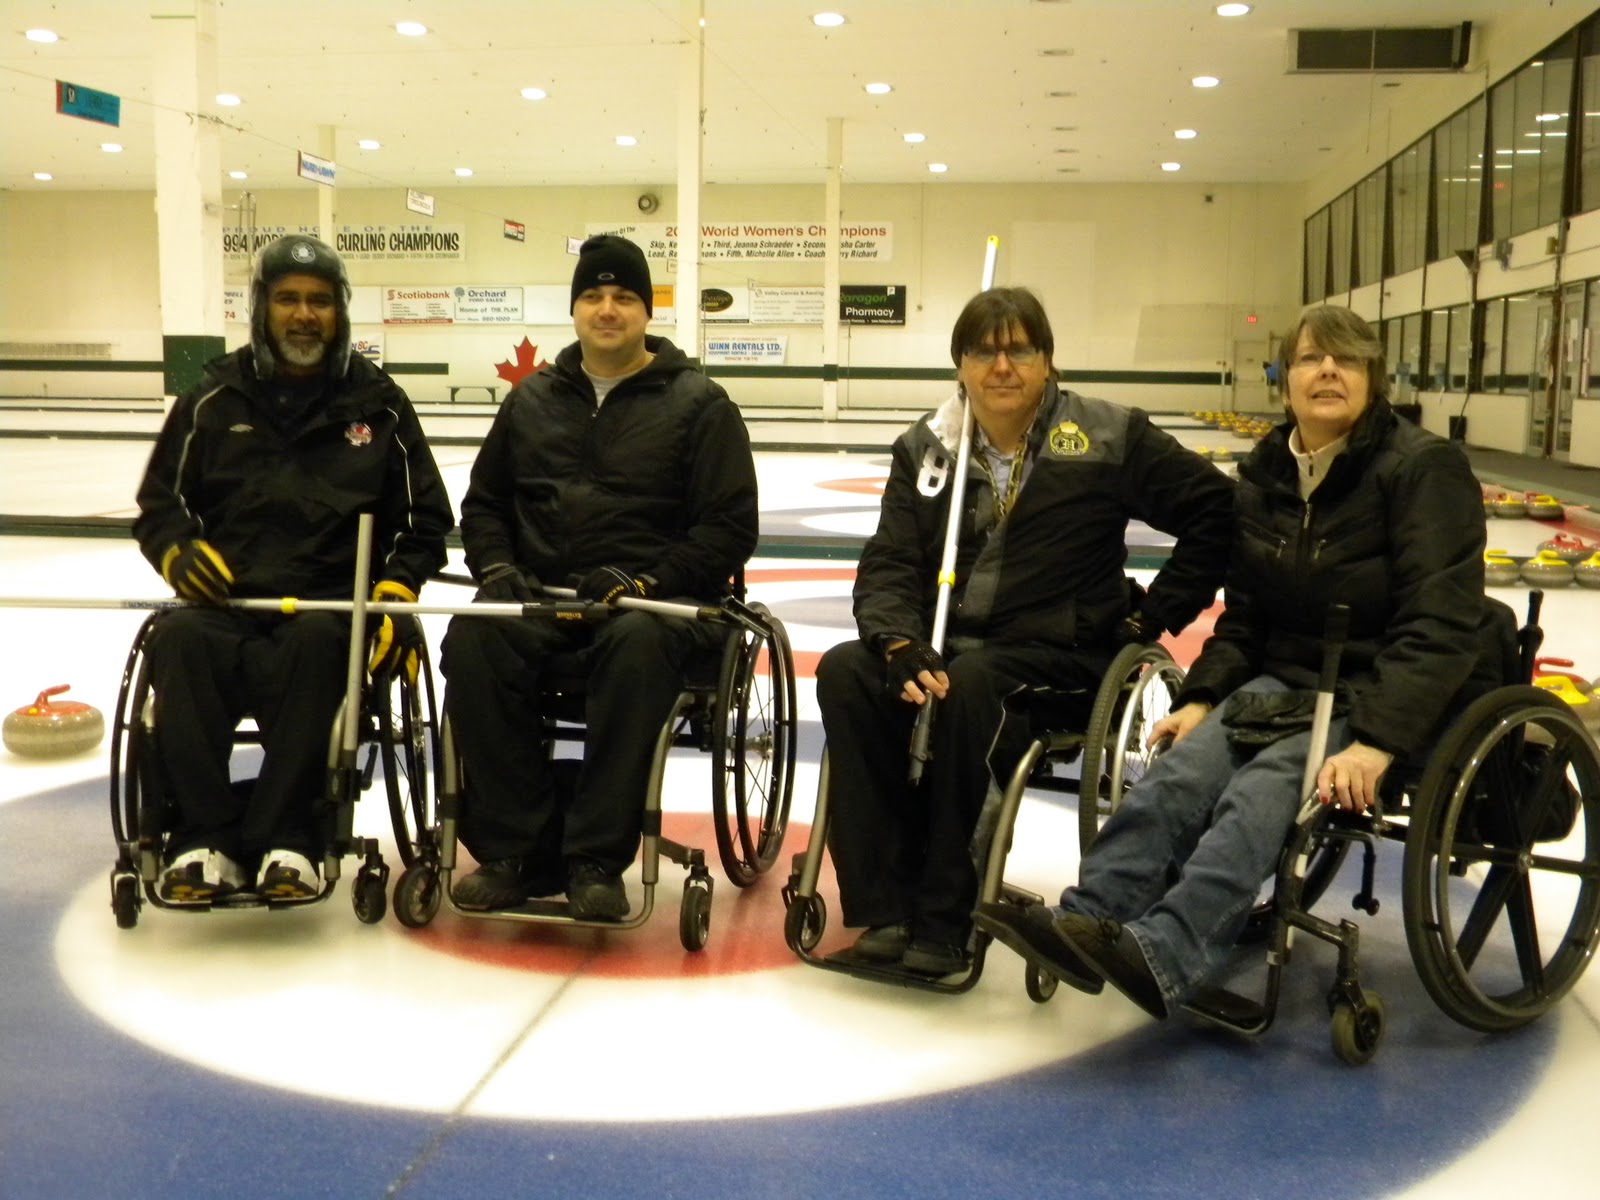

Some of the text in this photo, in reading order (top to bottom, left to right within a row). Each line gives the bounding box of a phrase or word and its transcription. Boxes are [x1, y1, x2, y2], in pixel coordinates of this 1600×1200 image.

[702, 226, 739, 237] World
[743, 226, 804, 237] Women's
[808, 225, 887, 239] Chmpions
[336, 233, 386, 252] CURLING
[389, 232, 460, 252] CHAMPIONS
[650, 240, 667, 249] Skip,
[713, 240, 733, 249] Third,
[854, 240, 876, 249] Carter
[648, 250, 667, 259] Lead,
[726, 250, 744, 259] Fifth,
[745, 250, 776, 258] Michelle
[776, 250, 795, 258] Allen
[850, 250, 878, 258] Richard
[397, 290, 450, 300] Scotiabank
[468, 289, 507, 298] Orchard
[845, 306, 895, 318] Pharmacy
[357, 341, 369, 350] BC
[708, 342, 783, 351] WINN RENTALS LTD.
